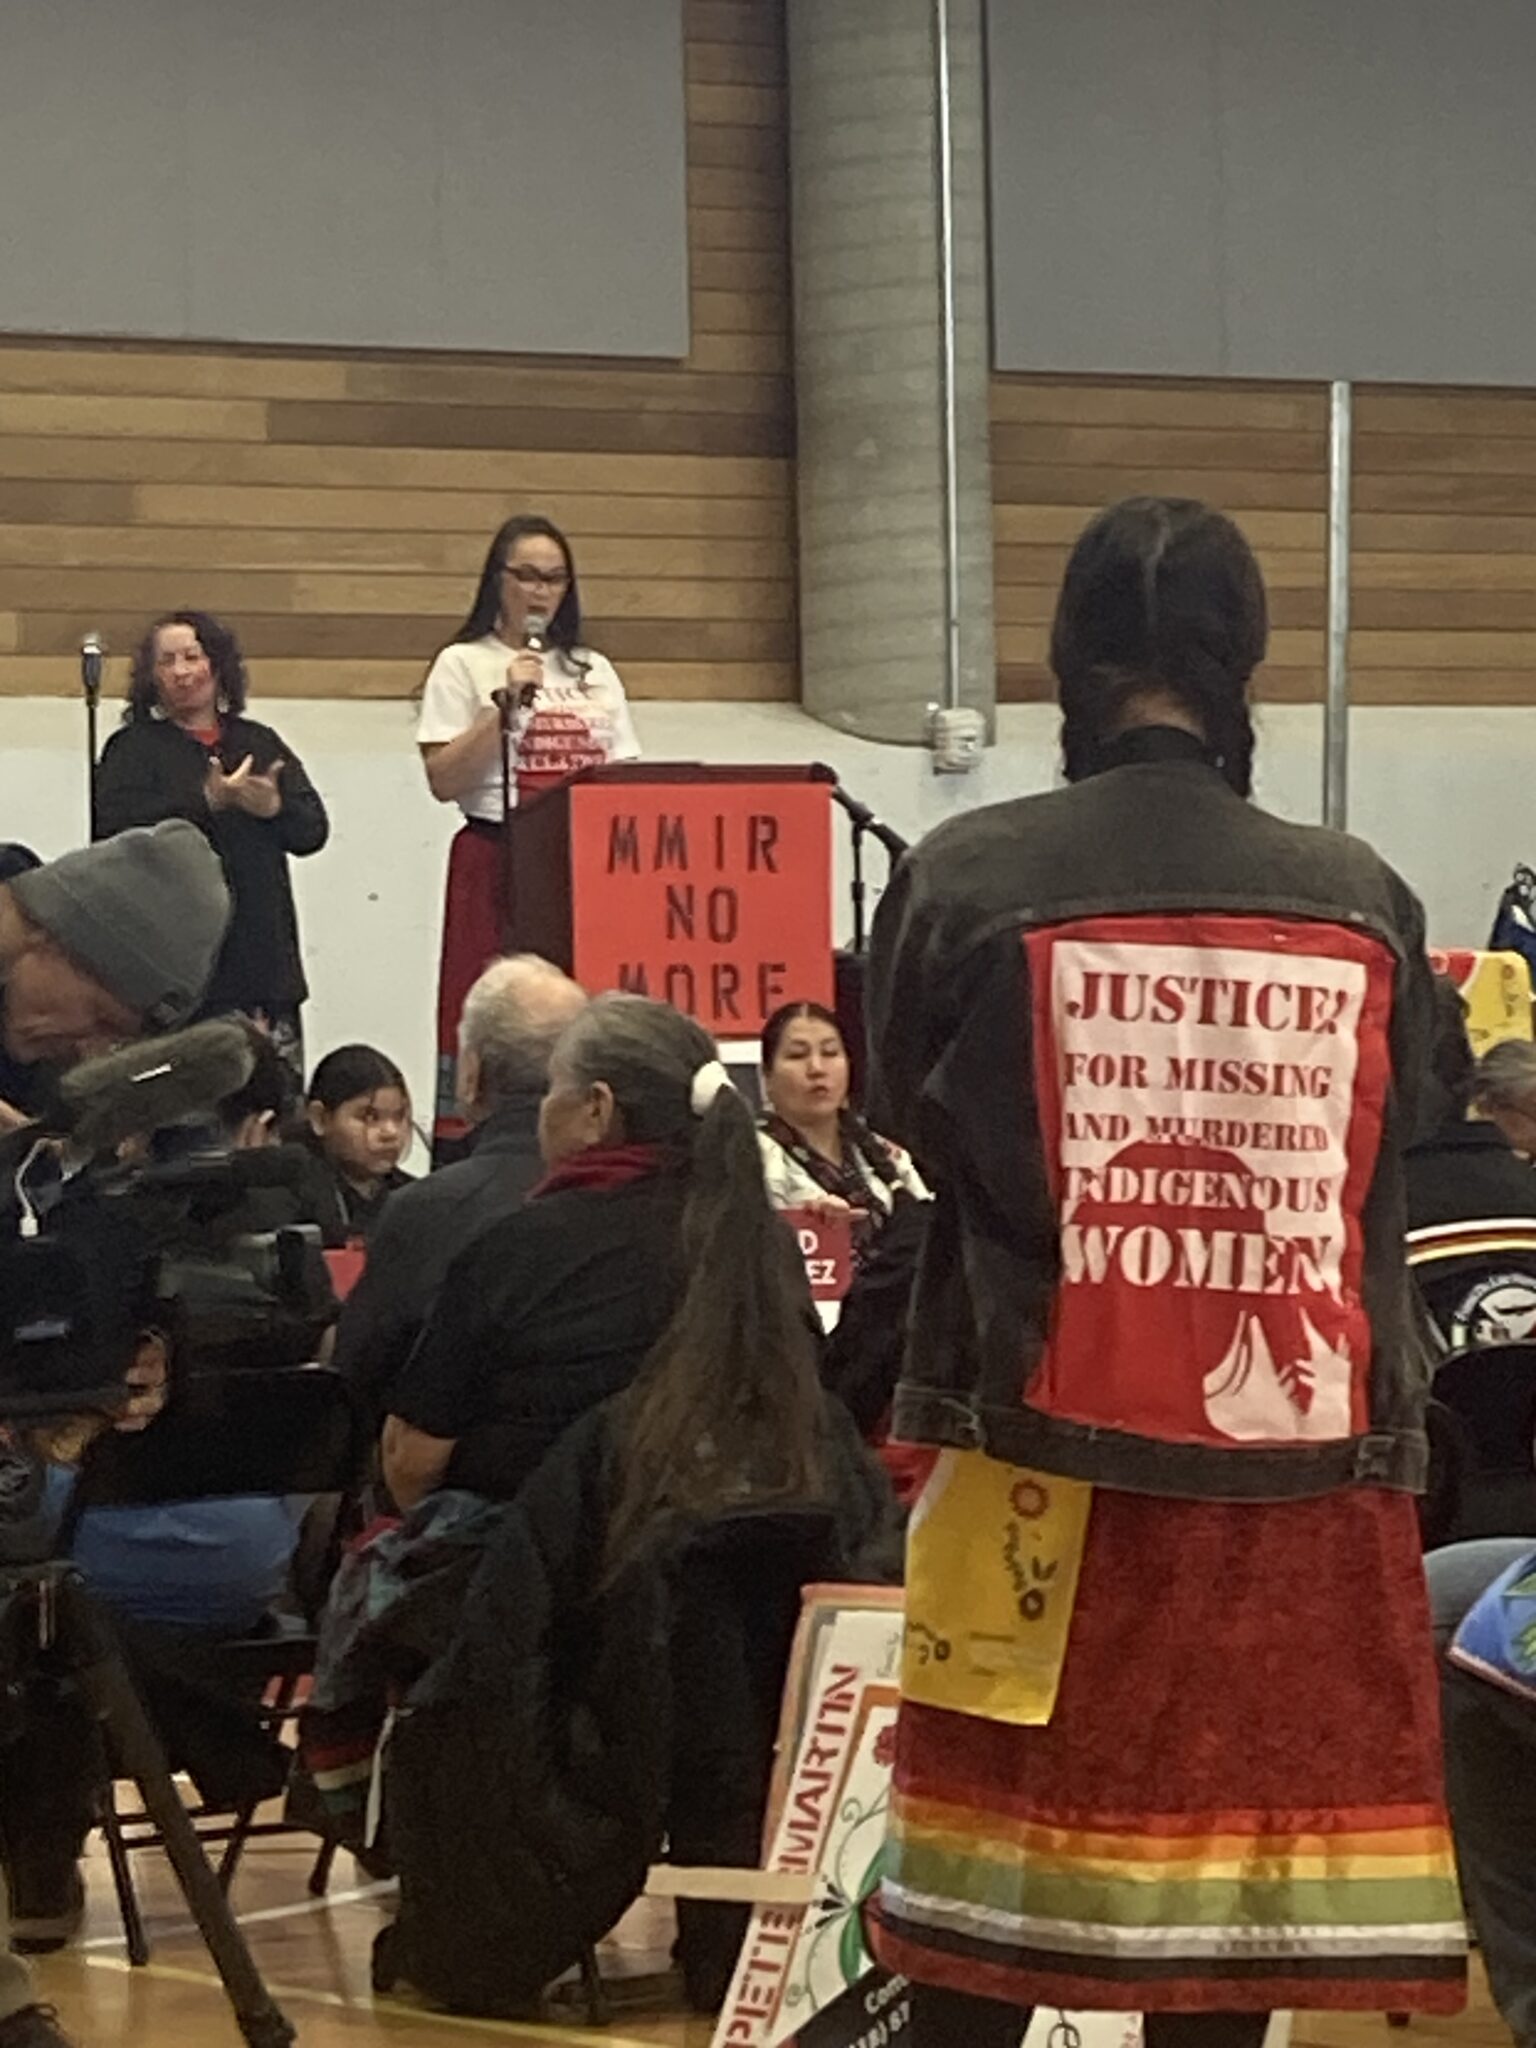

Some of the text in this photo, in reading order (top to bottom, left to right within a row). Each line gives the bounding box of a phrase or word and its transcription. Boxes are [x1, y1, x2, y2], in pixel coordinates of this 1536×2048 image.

[607, 814, 779, 874] MMIR
[666, 884, 739, 943] NO
[618, 962, 787, 1020] MORE
[1064, 1053, 1333, 1098] FOR MISSING
[1066, 1112, 1329, 1151] AND MURDERED
[804, 1258, 838, 1285] EZ
[1060, 1224, 1336, 1295] WOMEN
